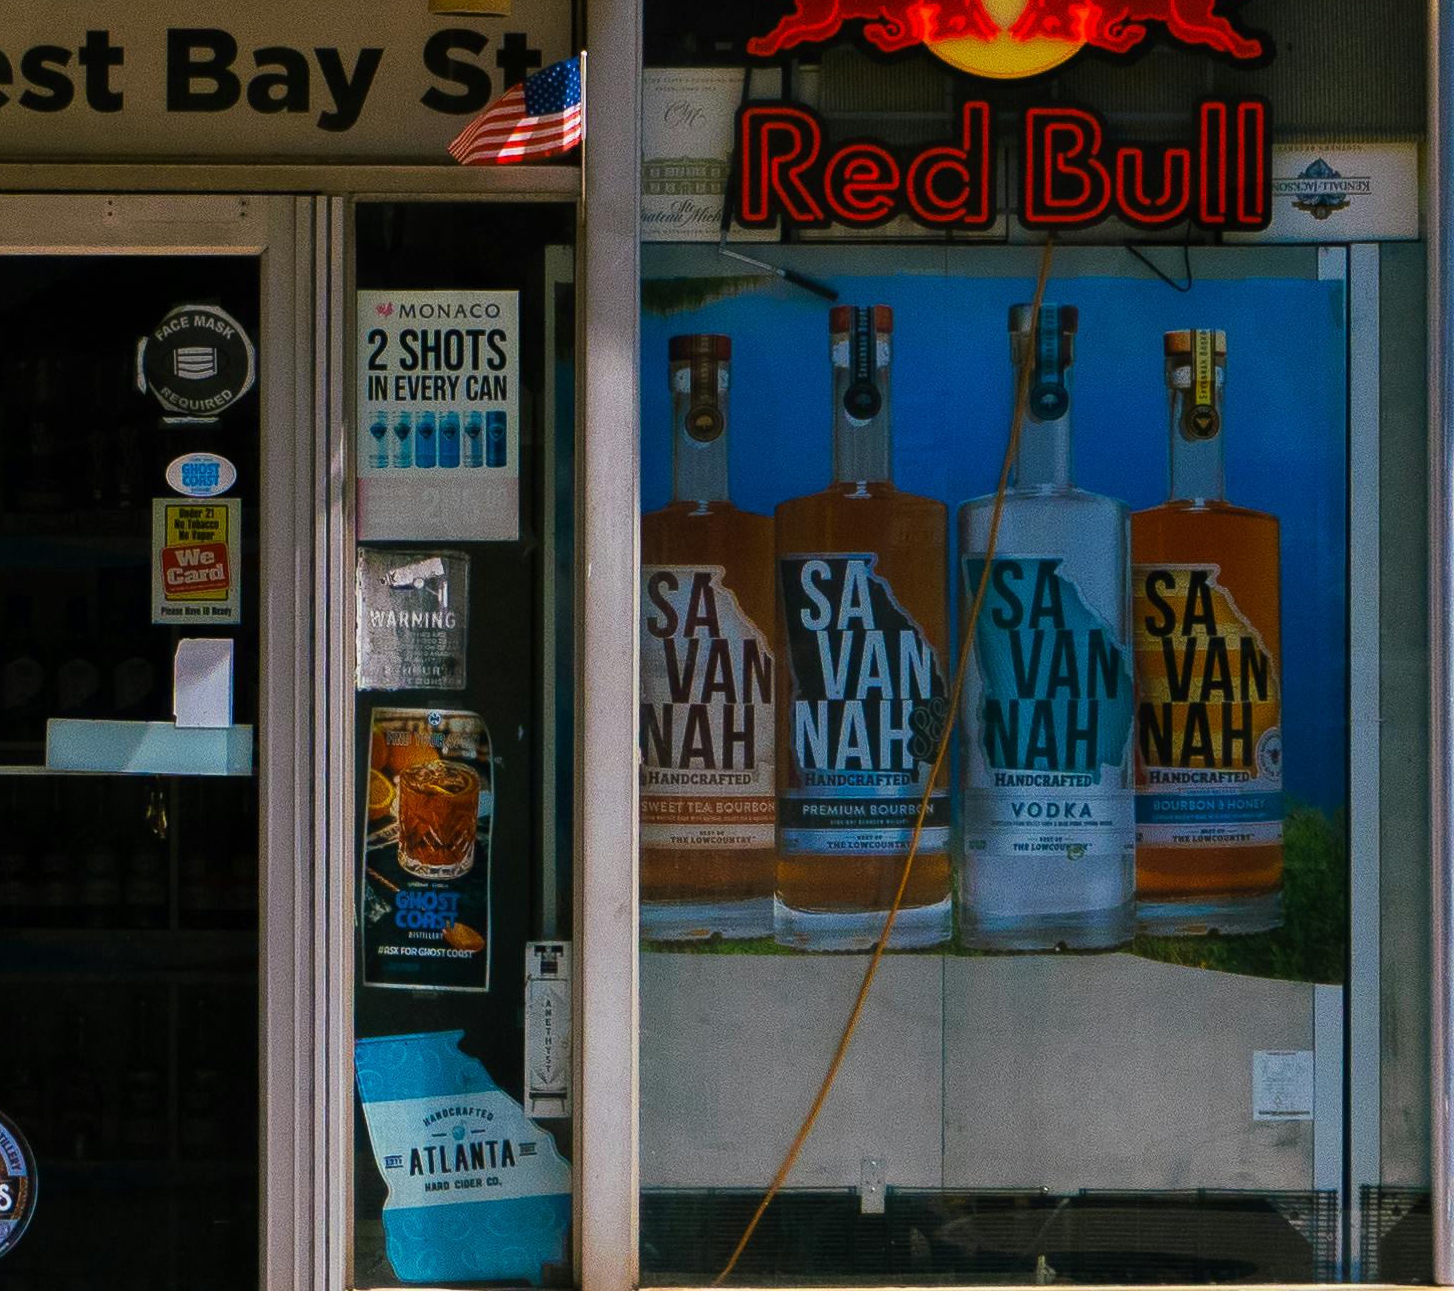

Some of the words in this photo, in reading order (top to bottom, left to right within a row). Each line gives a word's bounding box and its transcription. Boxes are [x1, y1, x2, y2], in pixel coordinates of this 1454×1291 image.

[166, 26, 384, 133] Bay
[421, 26, 544, 114] St
[740, 100, 991, 225] Red
[1024, 100, 1266, 225] Bull
[399, 303, 500, 319] MONACO
[155, 314, 190, 342] FACE
[194, 314, 236, 341] MASK
[367, 328, 388, 371] 2
[399, 328, 507, 371] SHOTS
[160, 384, 233, 411] REQUIRED
[368, 375, 388, 401] IN
[395, 375, 460, 401] EVERY
[465, 375, 507, 401] CAN
[179, 508, 203, 518] Under
[188, 519, 219, 529] Tobacco
[174, 548, 215, 567] We
[166, 563, 226, 585] Card
[647, 570, 720, 638] SA
[801, 560, 871, 631] SA
[992, 561, 1065, 630] SA
[1144, 570, 1213, 638] SA
[369, 610, 457, 628] WARNING
[664, 636, 772, 704] VAN
[820, 629, 934, 701] VAN
[1008, 628, 1121, 701] VAN
[1162, 636, 1270, 703] VAN
[641, 702, 755, 771] NAH
[794, 699, 914, 772] NAH
[991, 699, 1096, 774] NAH
[1139, 701, 1252, 769] NAH
[648, 772, 751, 786] HANDCRAFTED
[804, 773, 911, 787] HANDCRAFTED
[994, 772, 1092, 787] HANDCRAFTED
[1149, 770, 1250, 784] HANDCRAFTED
[641, 801, 683, 814] SWEET
[687, 801, 711, 814] TEA
[715, 801, 775, 814] BOURBON
[802, 804, 865, 816] PREMIUM
[870, 804, 935, 816] BOURBON
[1011, 802, 1093, 818] VODKA
[1153, 800, 1214, 811] BOURBON
[1227, 799, 1265, 810] HONEY
[670, 836, 690, 845] THE
[692, 836, 751, 845] LOWCOUNTRY
[827, 841, 845, 849] THE
[1013, 842, 1030, 851] THE
[1172, 834, 1193, 843] THE
[1196, 834, 1251, 843] LOWCOUNTRY
[394, 890, 461, 910] GHOST
[400, 946, 418, 956] FOR
[418, 947, 446, 958] GHOST
[423, 1106, 494, 1127] HANDCRAFTED
[409, 1138, 515, 1176] ATLANTA
[424, 1181, 450, 1192] HARD
[454, 1179, 483, 1190] CIDER
